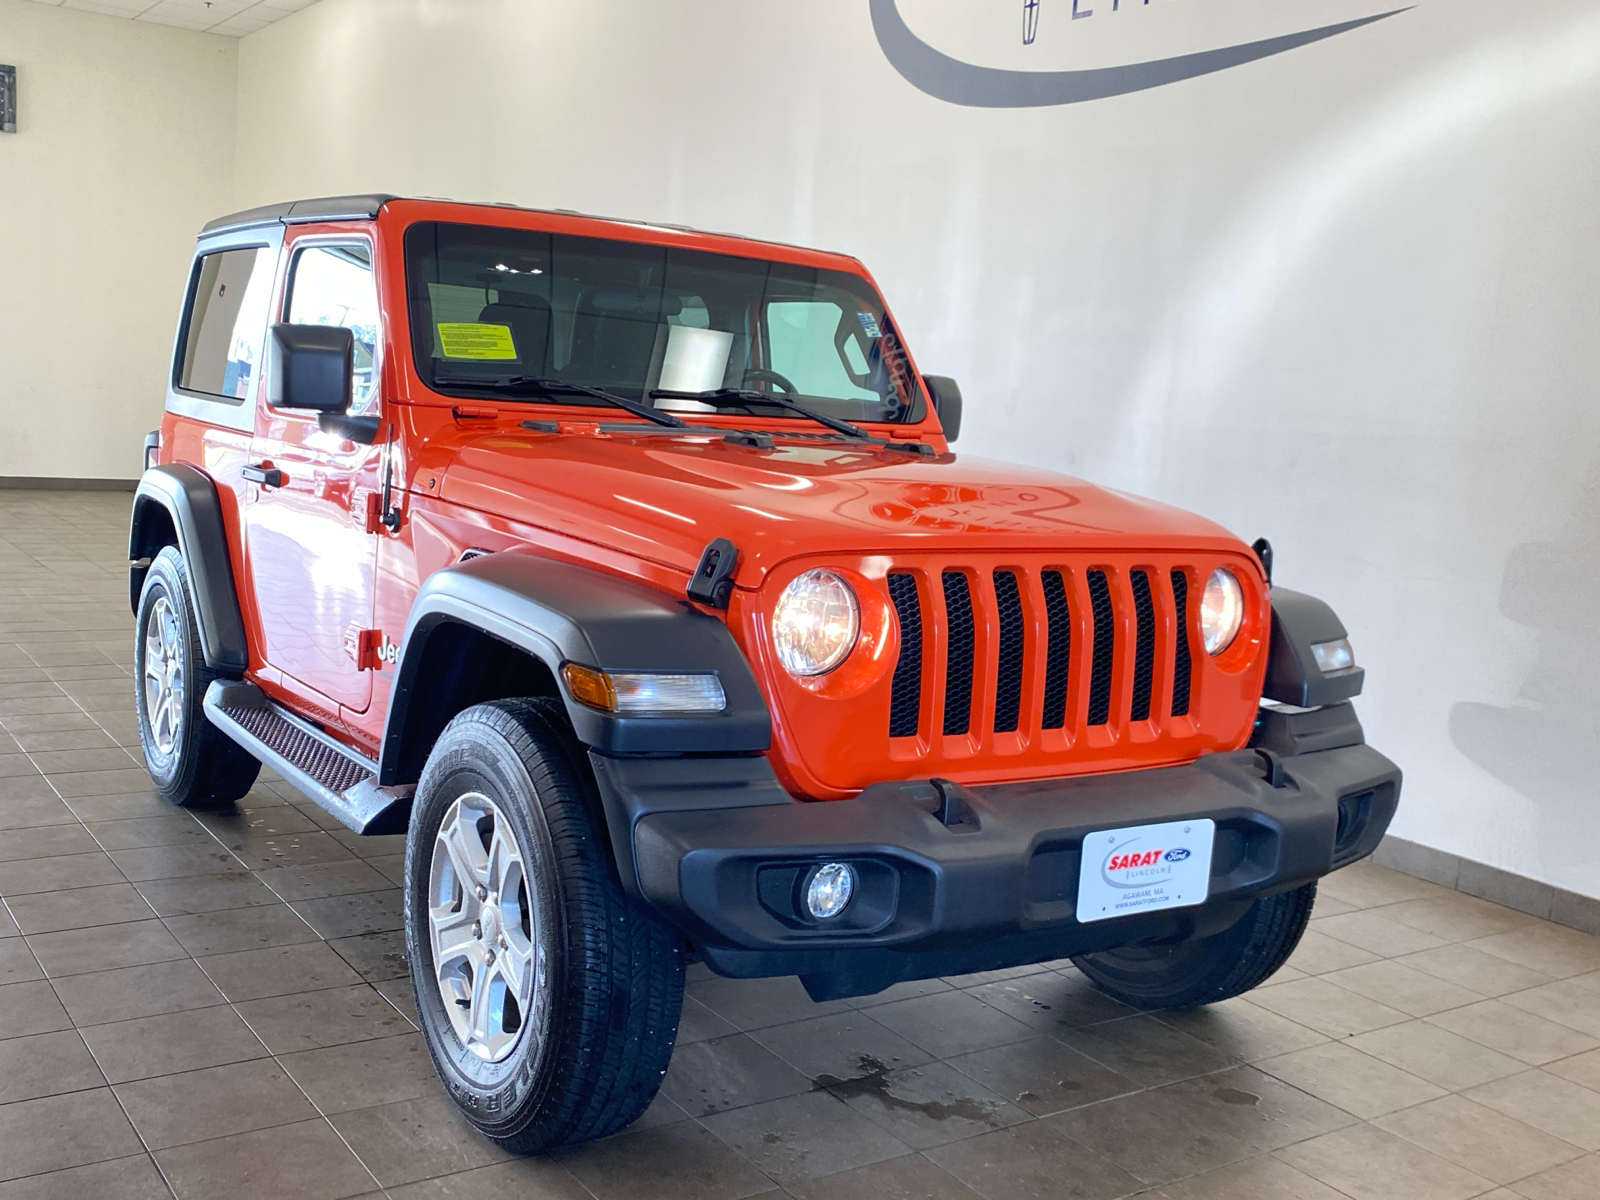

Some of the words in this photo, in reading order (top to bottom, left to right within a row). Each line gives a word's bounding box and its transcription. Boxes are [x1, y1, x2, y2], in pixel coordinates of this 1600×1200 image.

[377, 635, 400, 664] Je
[1108, 849, 1164, 870] SARAT
[1166, 849, 1190, 862] Ford
[1131, 867, 1166, 878] LINCOLN
[1122, 890, 1152, 900] AGAWAM,
[1153, 888, 1164, 896] MA
[1114, 896, 1170, 909] WWW.SARATFORD.COM
